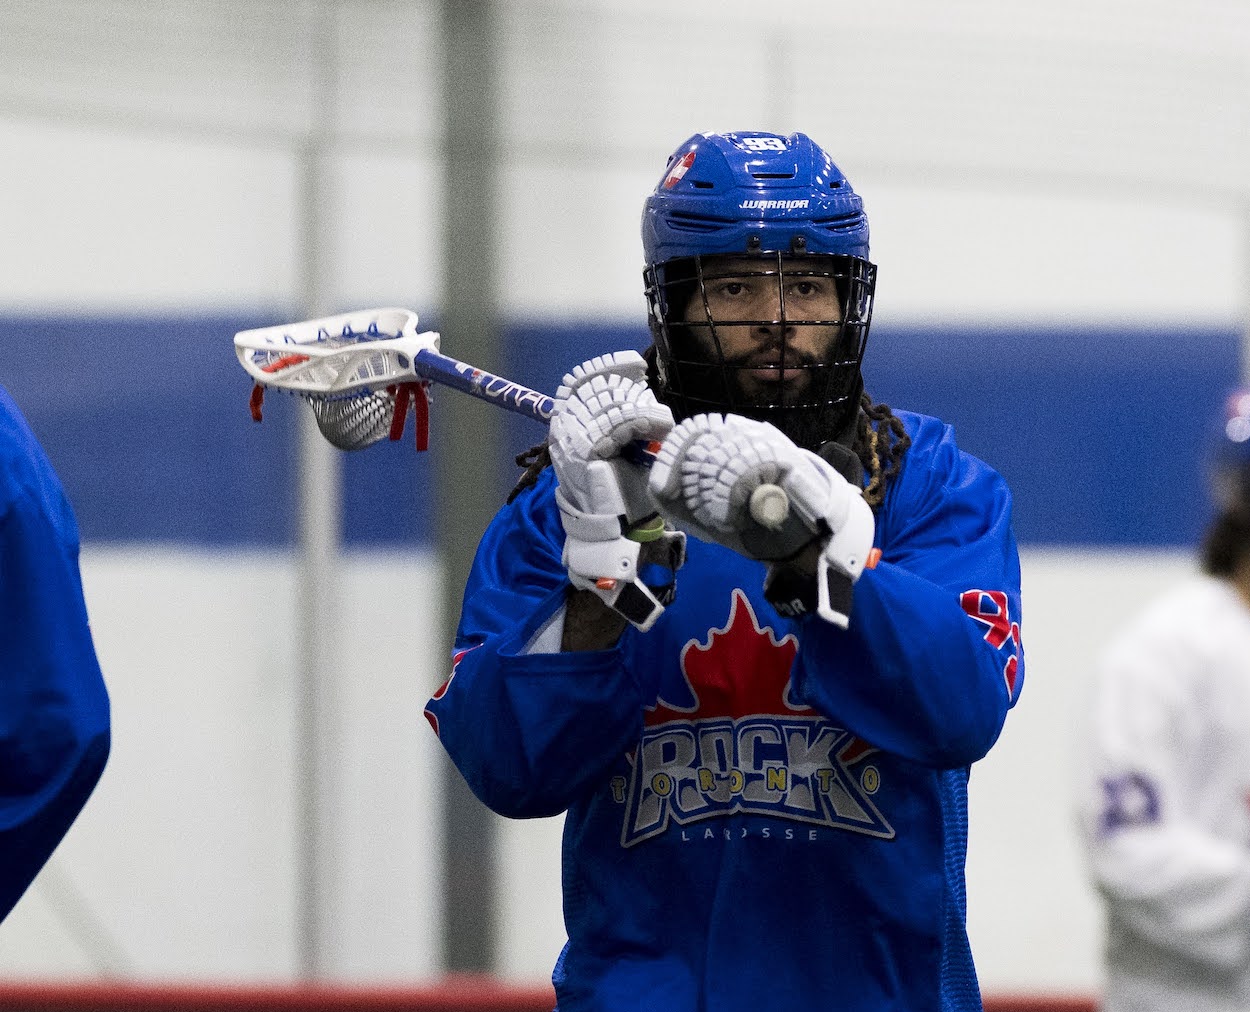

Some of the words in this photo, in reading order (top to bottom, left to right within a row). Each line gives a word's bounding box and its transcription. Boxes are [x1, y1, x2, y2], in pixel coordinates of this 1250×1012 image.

[743, 138, 787, 151] 93
[741, 200, 810, 209] WARRIOR
[611, 765, 881, 803] TORONTO
[626, 718, 889, 842] ROCK
